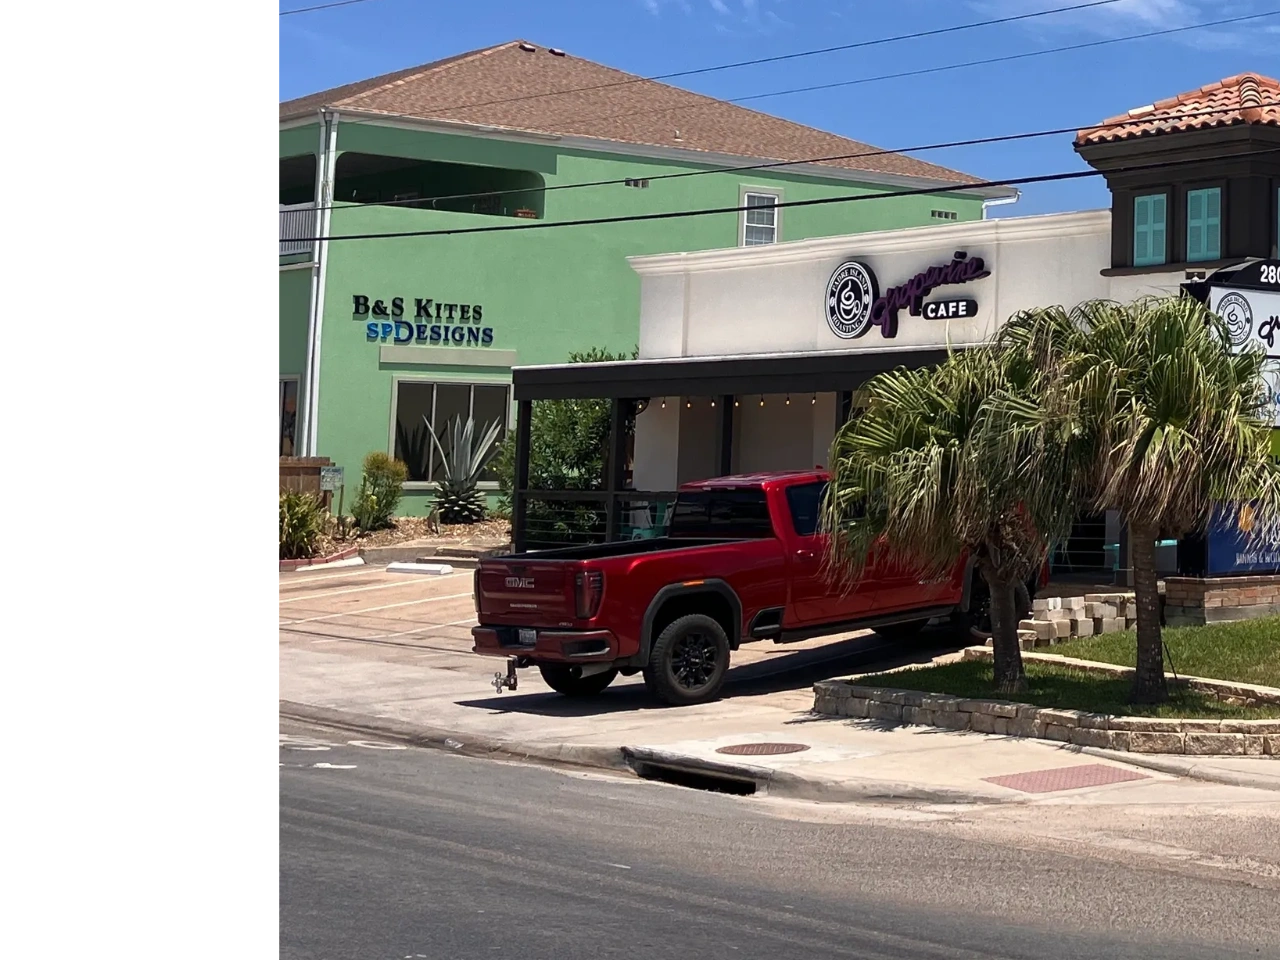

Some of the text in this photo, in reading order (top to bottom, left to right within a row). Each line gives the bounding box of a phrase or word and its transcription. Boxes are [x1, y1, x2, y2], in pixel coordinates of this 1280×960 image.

[831, 268, 868, 292] PADRE ISLAND
[352, 295, 404, 318] B&S
[926, 301, 967, 318] CAFE
[832, 314, 860, 333] ROASTING
[505, 577, 535, 589] GMC
